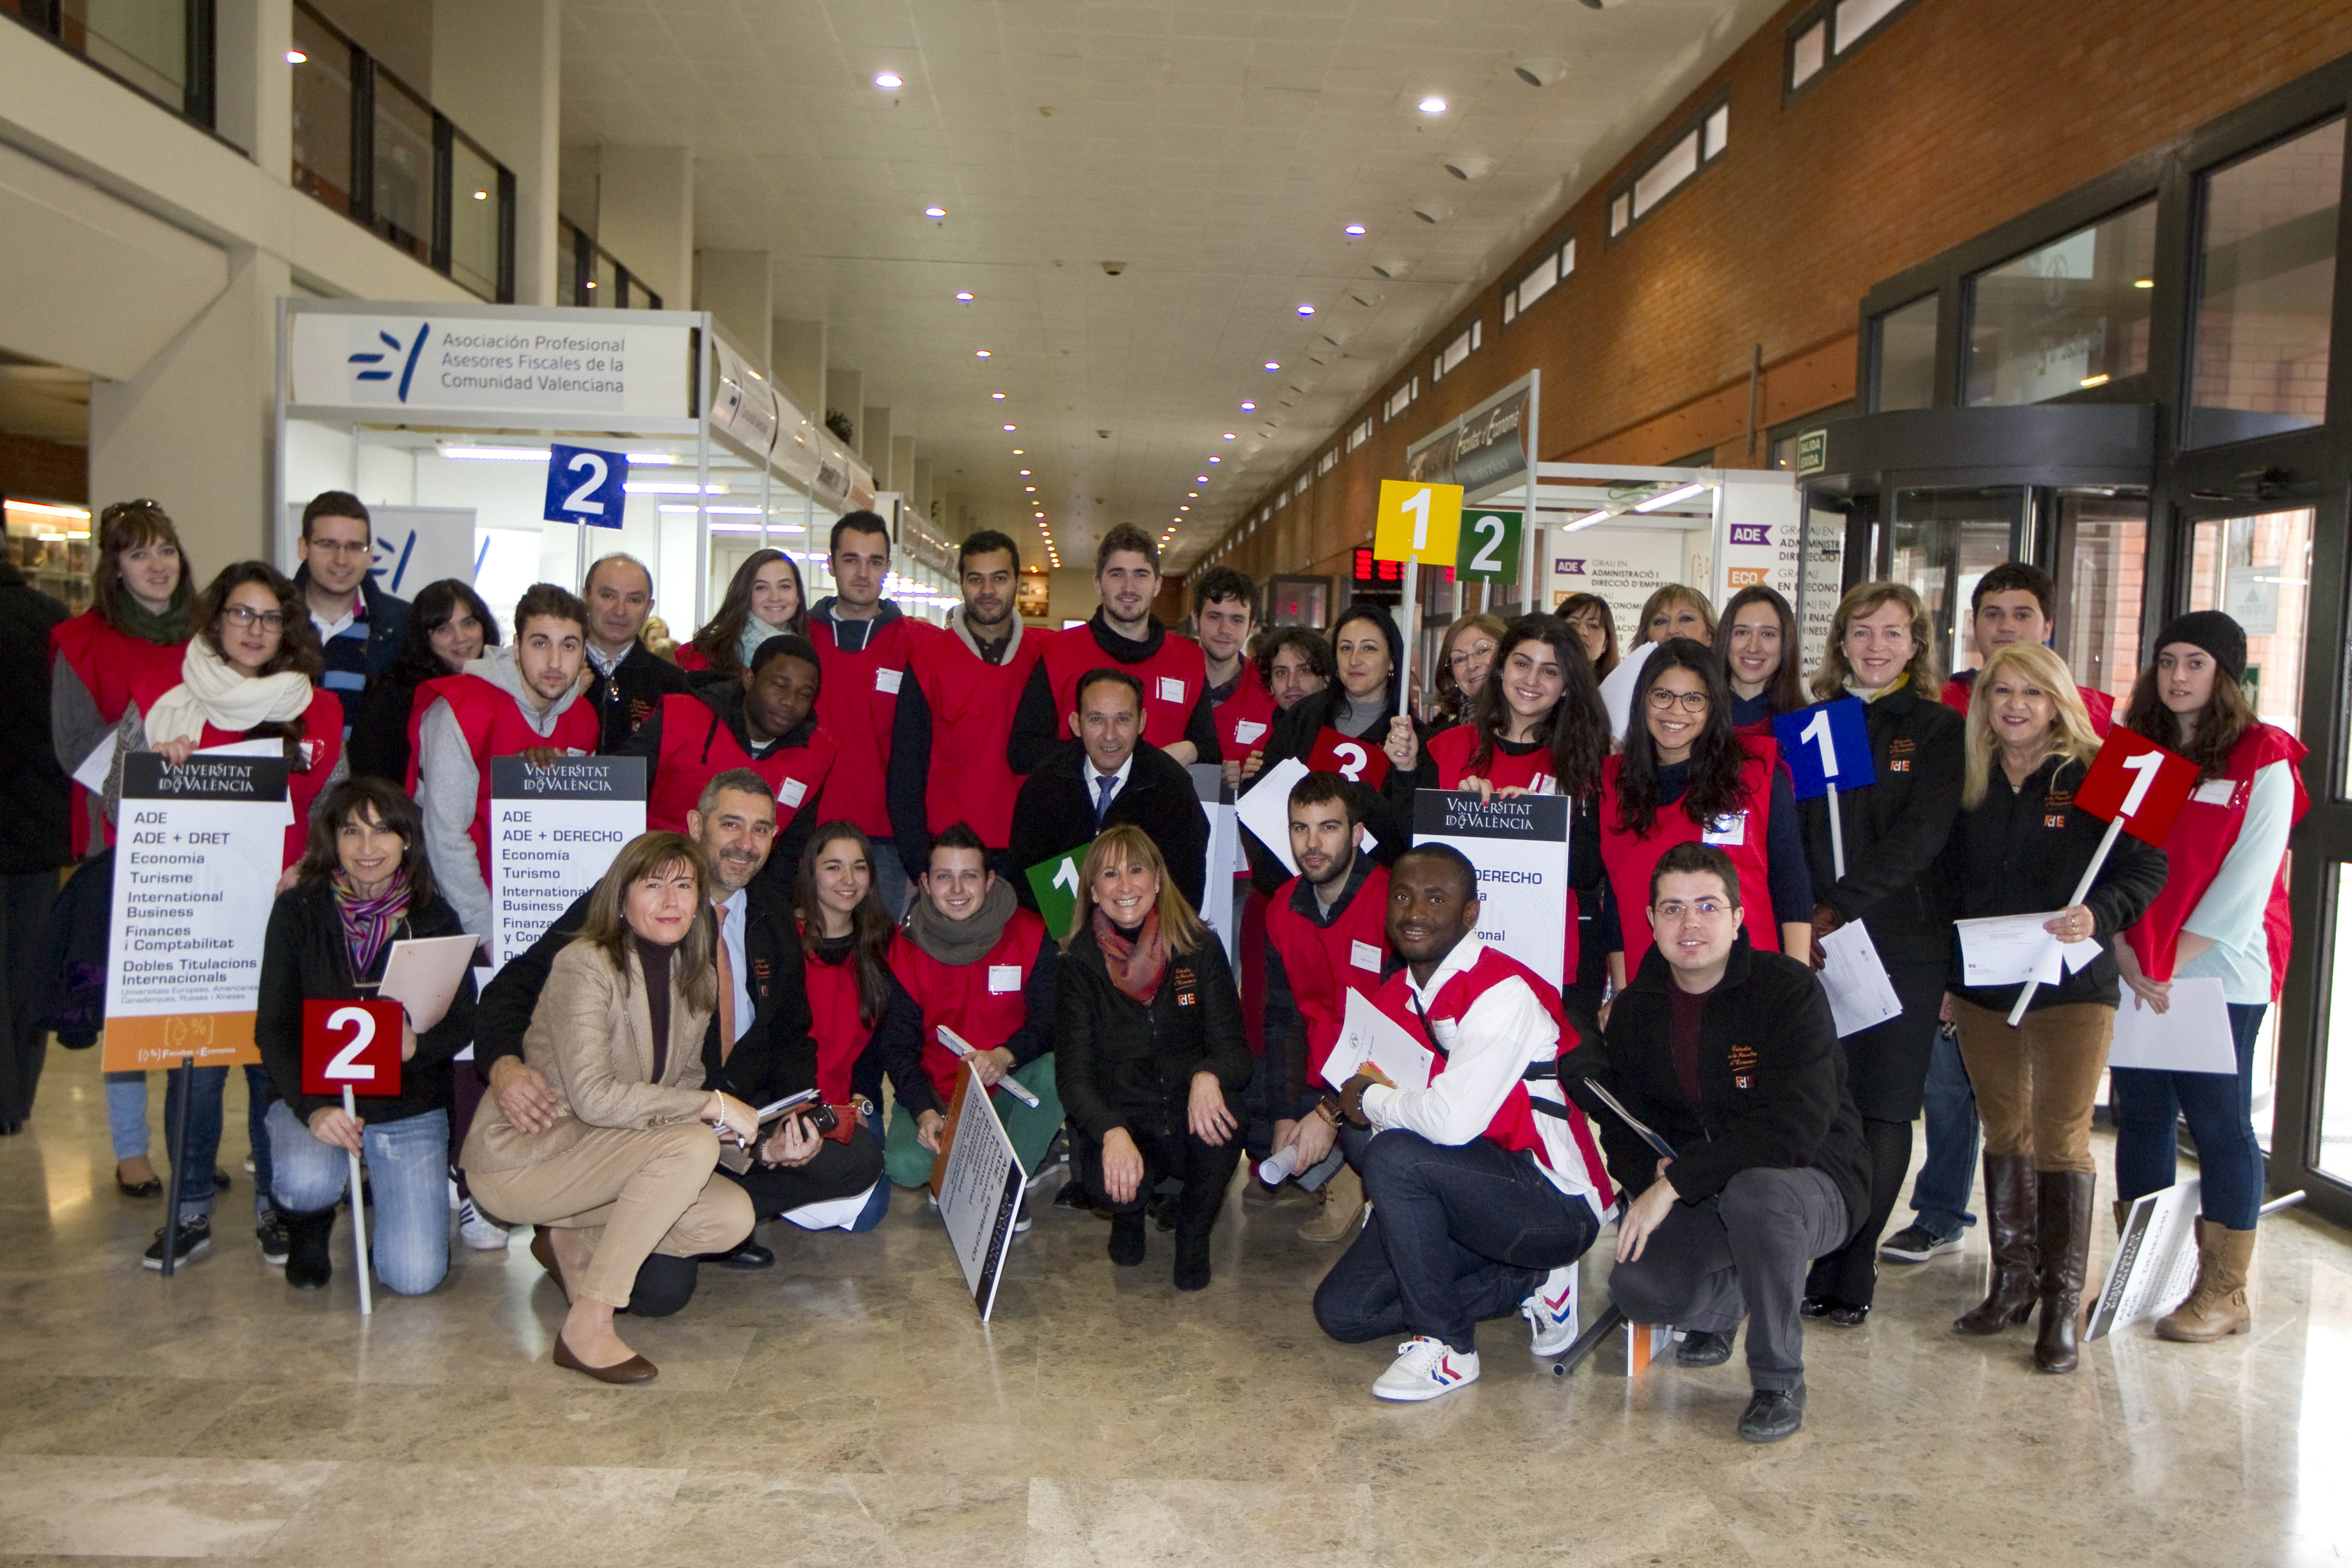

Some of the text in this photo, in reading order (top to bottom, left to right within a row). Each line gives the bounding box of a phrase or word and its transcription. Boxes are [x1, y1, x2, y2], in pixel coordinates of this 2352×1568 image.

[442, 333, 625, 352] Asociación Profesional
[442, 352, 624, 372] Asesores Fiscales de la
[441, 372, 624, 393] Comunidad Valenciana
[563, 453, 608, 514] 2
[1402, 489, 1431, 550] 1
[1734, 528, 1761, 541] ADE
[1822, 527, 1834, 536] EN
[1470, 516, 1505, 571] 2
[1558, 562, 1578, 572] ADE
[1592, 570, 1654, 578] ADMINISTRACIÓ
[1732, 571, 1758, 584] ECO
[1592, 579, 1629, 587] DIRECCIÓ
[1778, 583, 1790, 591] EN
[1557, 594, 1568, 603] EC
[1801, 710, 1838, 778] 1
[1333, 743, 1367, 781] 3
[2122, 750, 2165, 817] 1
[135, 812, 167, 823] ADE
[503, 811, 532, 822] ADE
[133, 832, 231, 844] ADE + DRET
[503, 830, 623, 842] ADE + DERECHO
[131, 852, 204, 864] Economia
[502, 849, 569, 860] Economía
[131, 871, 193, 883] Turisme
[503, 867, 560, 878] Turismo
[128, 891, 223, 903] International
[503, 900, 564, 911] Business
[127, 906, 194, 918] Business
[503, 918, 553, 928] Finanza
[126, 925, 191, 937] Finances
[504, 934, 511, 944] y
[125, 938, 234, 953] i Comptabilitat
[123, 958, 257, 972] Dobles Titulacions
[122, 971, 227, 985] Internacionals
[325, 1007, 376, 1078] 2
[993, 1148, 1004, 1180] ADE
[997, 1156, 1007, 1189] ADE
[971, 1195, 991, 1263] DERECHO
